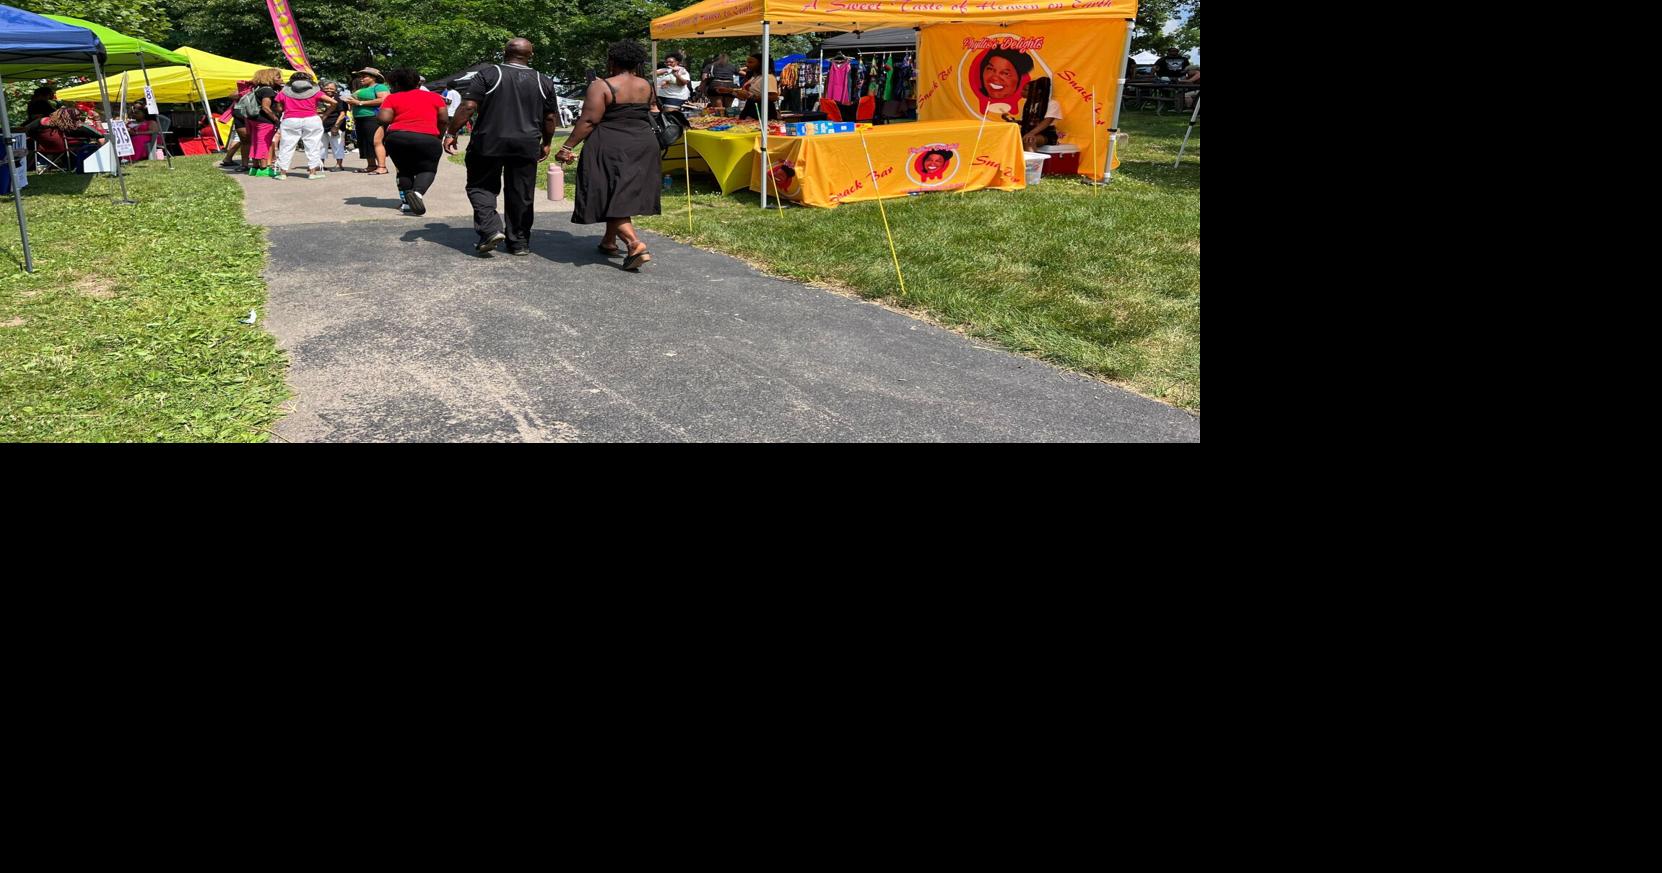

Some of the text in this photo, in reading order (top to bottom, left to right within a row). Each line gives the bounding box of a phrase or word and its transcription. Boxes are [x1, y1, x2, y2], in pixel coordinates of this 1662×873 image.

[800, 0, 817, 13] A
[825, 1, 882, 13] Sweet
[951, 0, 968, 14] of
[1000, 37, 1044, 54] Delights
[1057, 70, 1093, 103] Snack
[866, 166, 894, 182] Bar
